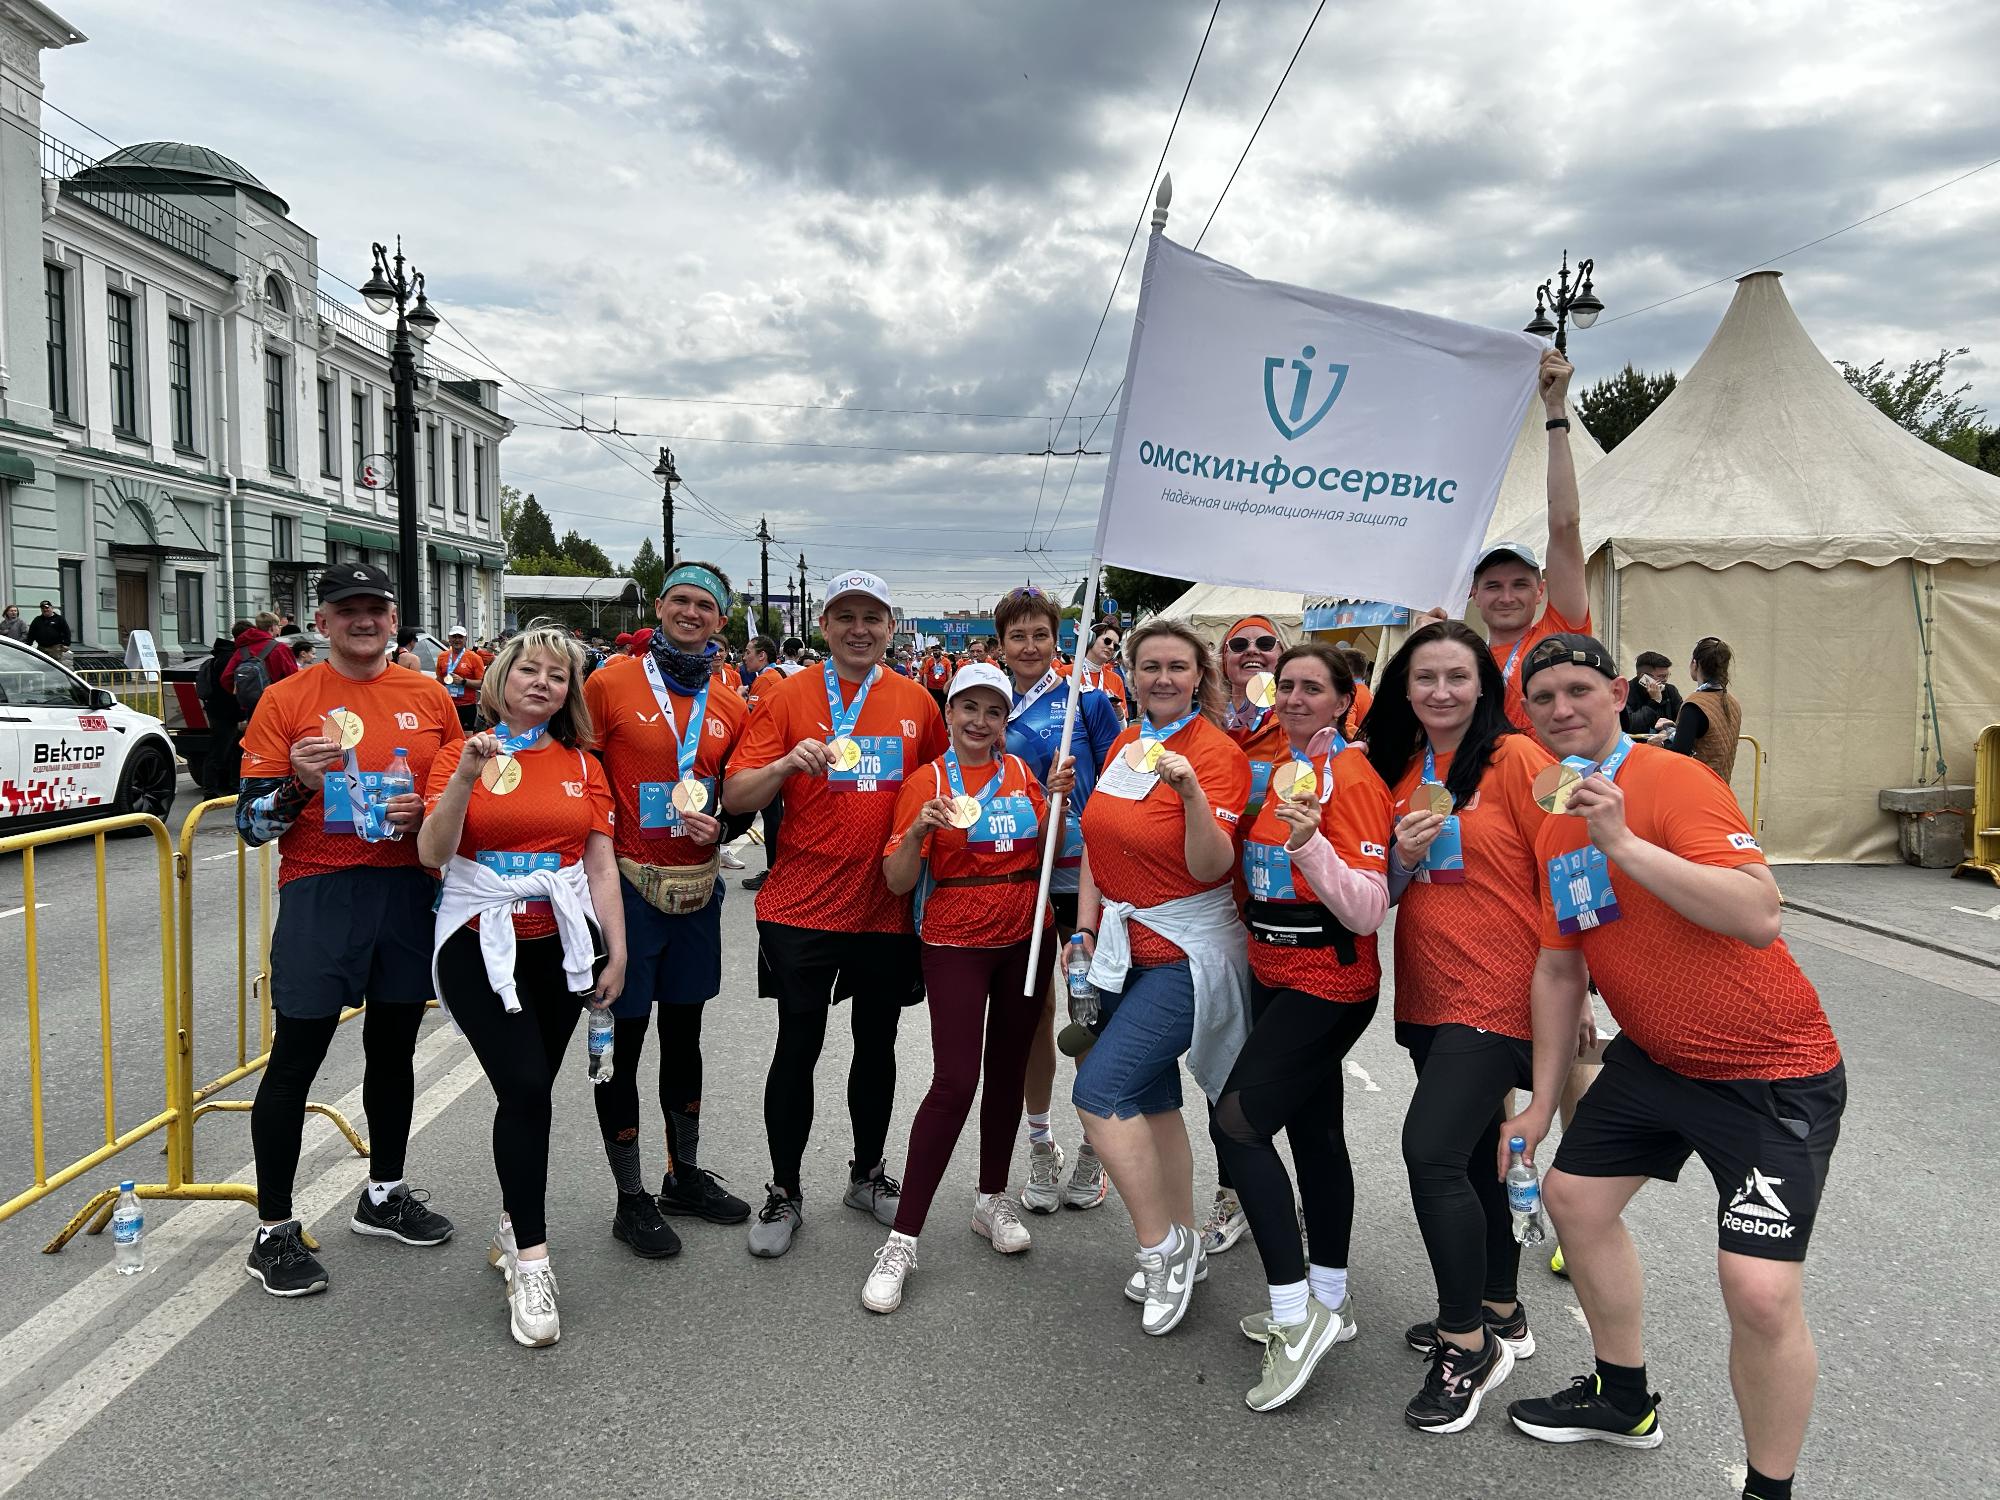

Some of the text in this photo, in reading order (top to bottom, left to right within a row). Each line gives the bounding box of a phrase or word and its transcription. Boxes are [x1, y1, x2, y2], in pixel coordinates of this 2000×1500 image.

[1139, 440, 1458, 504] омскинфосервис
[1161, 487, 1408, 528] Надёжная информационная защита
[80, 718, 107, 729] BLACK
[856, 779, 878, 792] 5KM
[988, 814, 1017, 835] 3175
[994, 839, 1014, 853] 5KM
[1252, 865, 1271, 890] 3184
[1568, 875, 1593, 906] 1180
[1576, 909, 1600, 931] 10KM
[1721, 1211, 1796, 1239] Reebok
